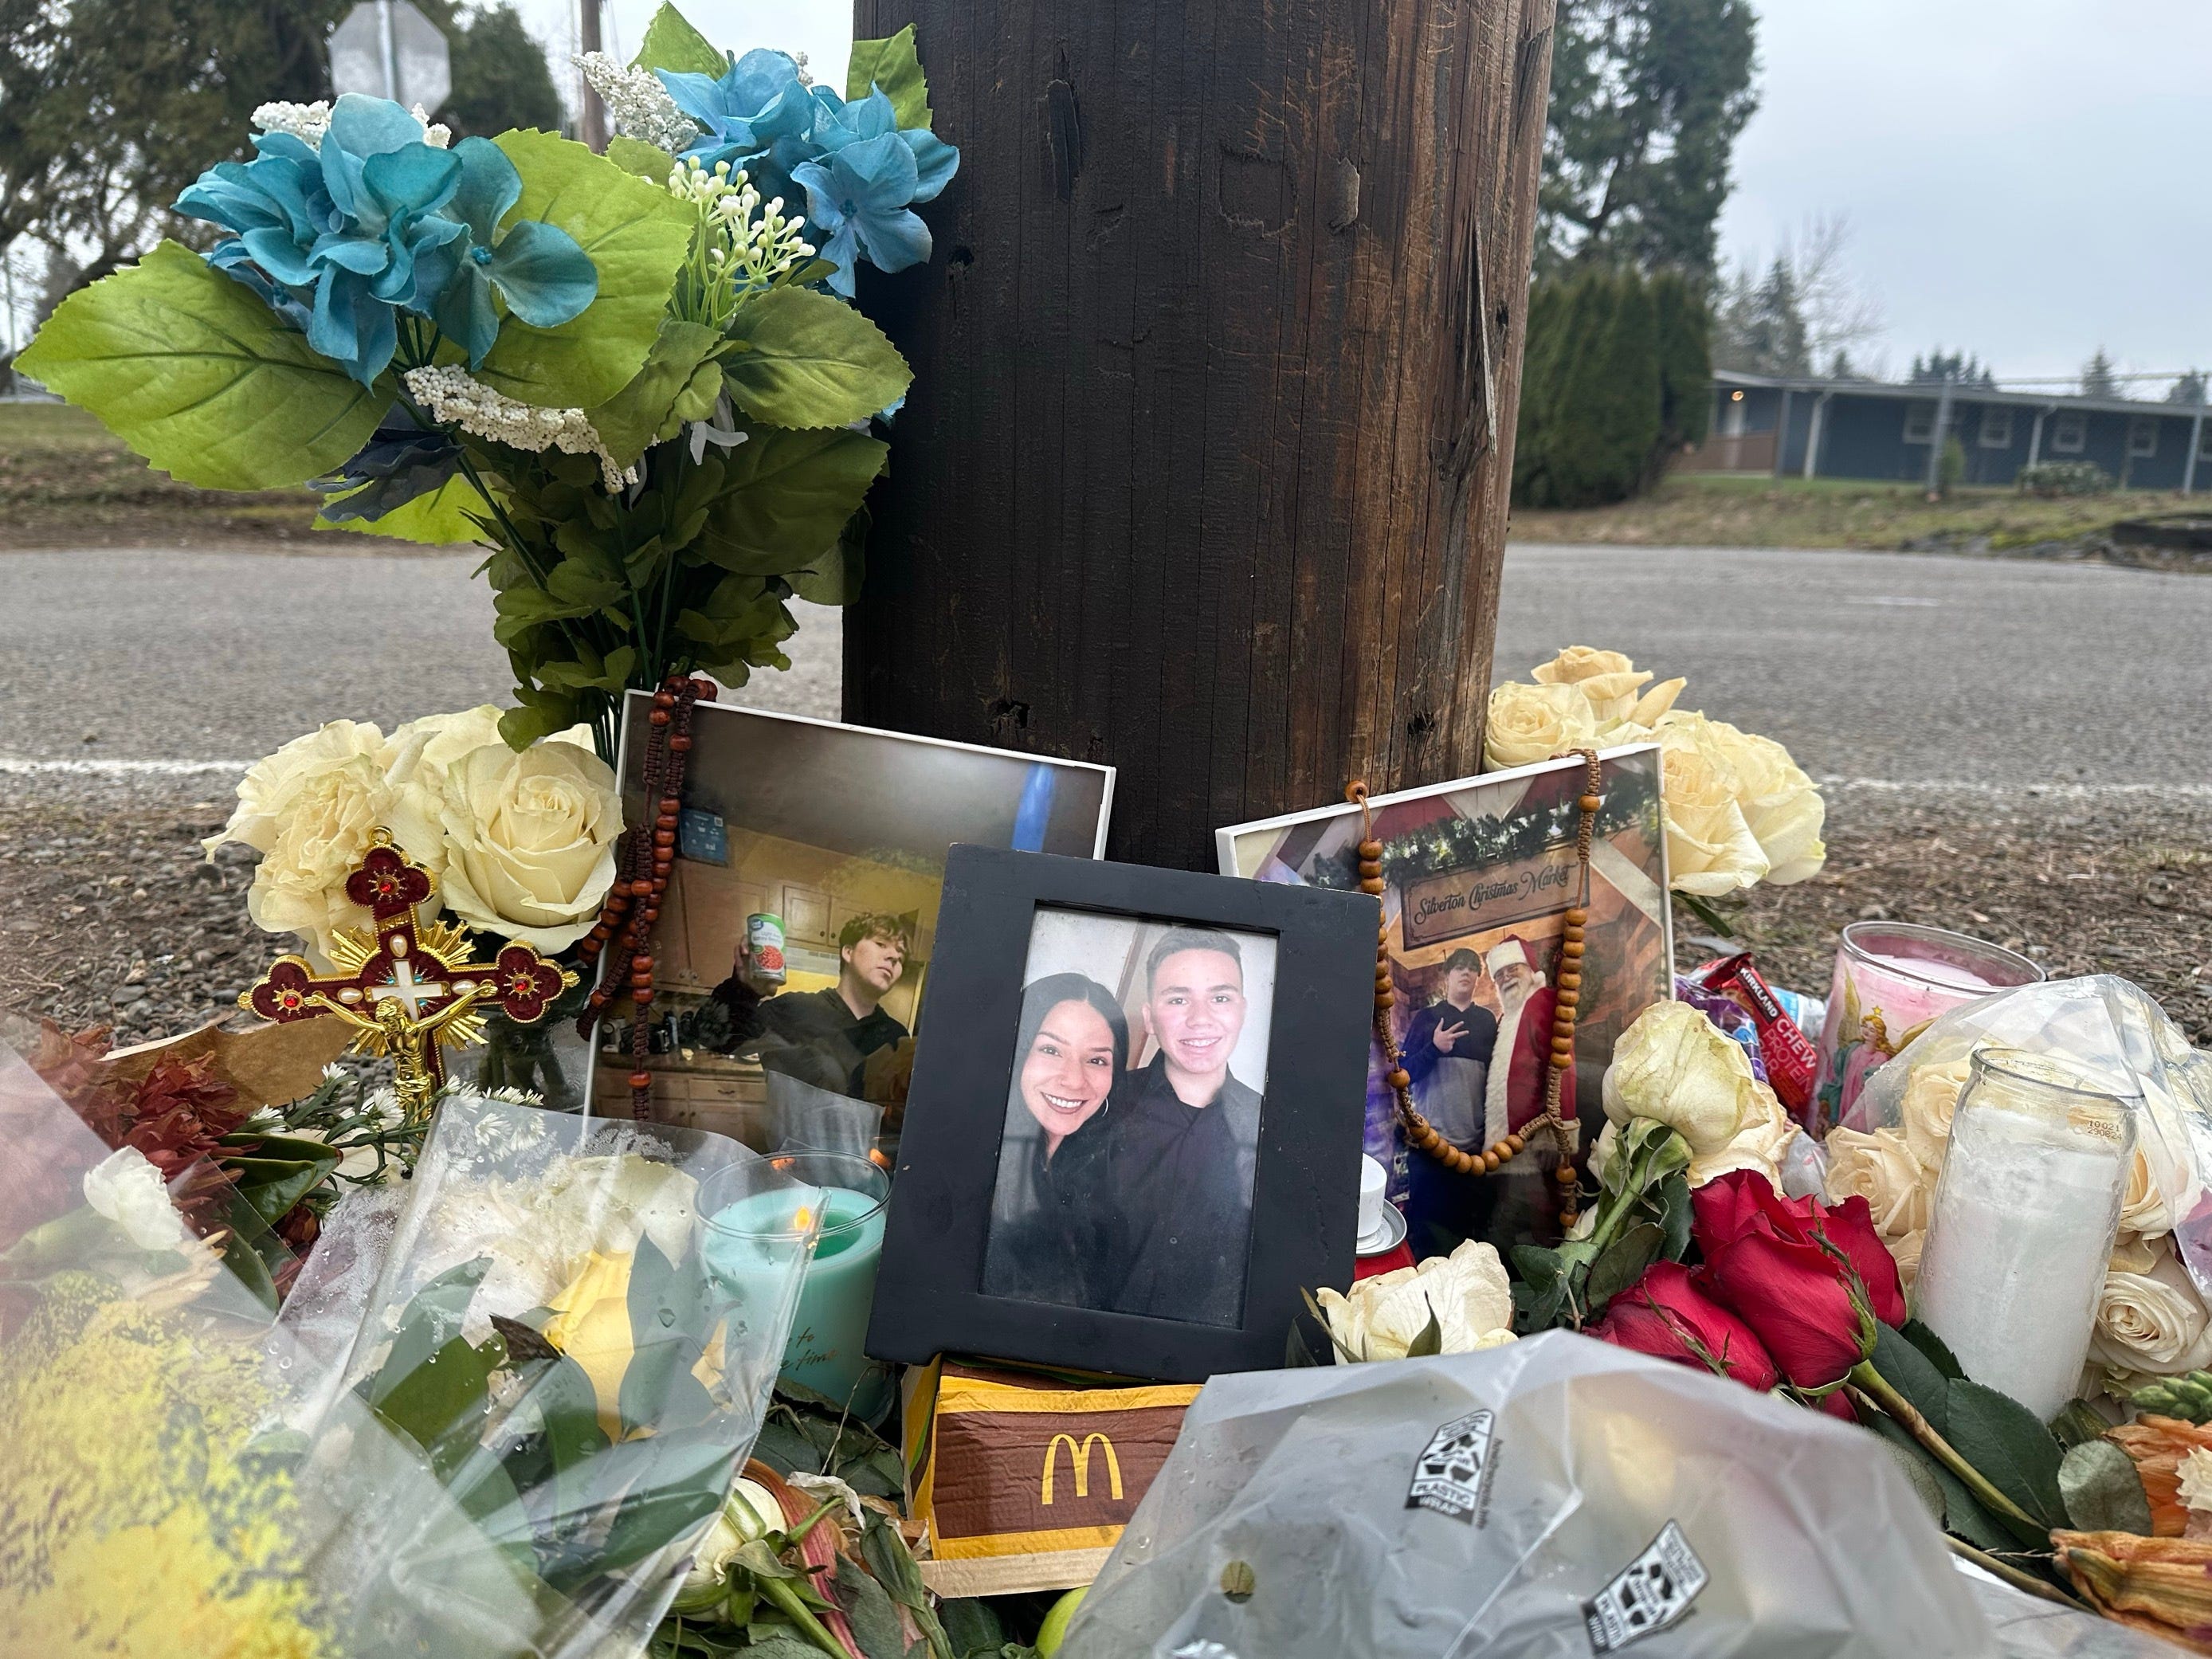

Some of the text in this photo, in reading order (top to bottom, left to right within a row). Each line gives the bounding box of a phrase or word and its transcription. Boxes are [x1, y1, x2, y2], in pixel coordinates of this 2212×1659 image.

[1414, 863, 1578, 925] Silverton Christmas Market
[1739, 967, 1779, 1018] KIRKLAND
[1776, 1018, 1816, 1069] CHEW
[1416, 1483, 1470, 1504] PLASTIC
[1418, 1496, 1461, 1514] WRAP
